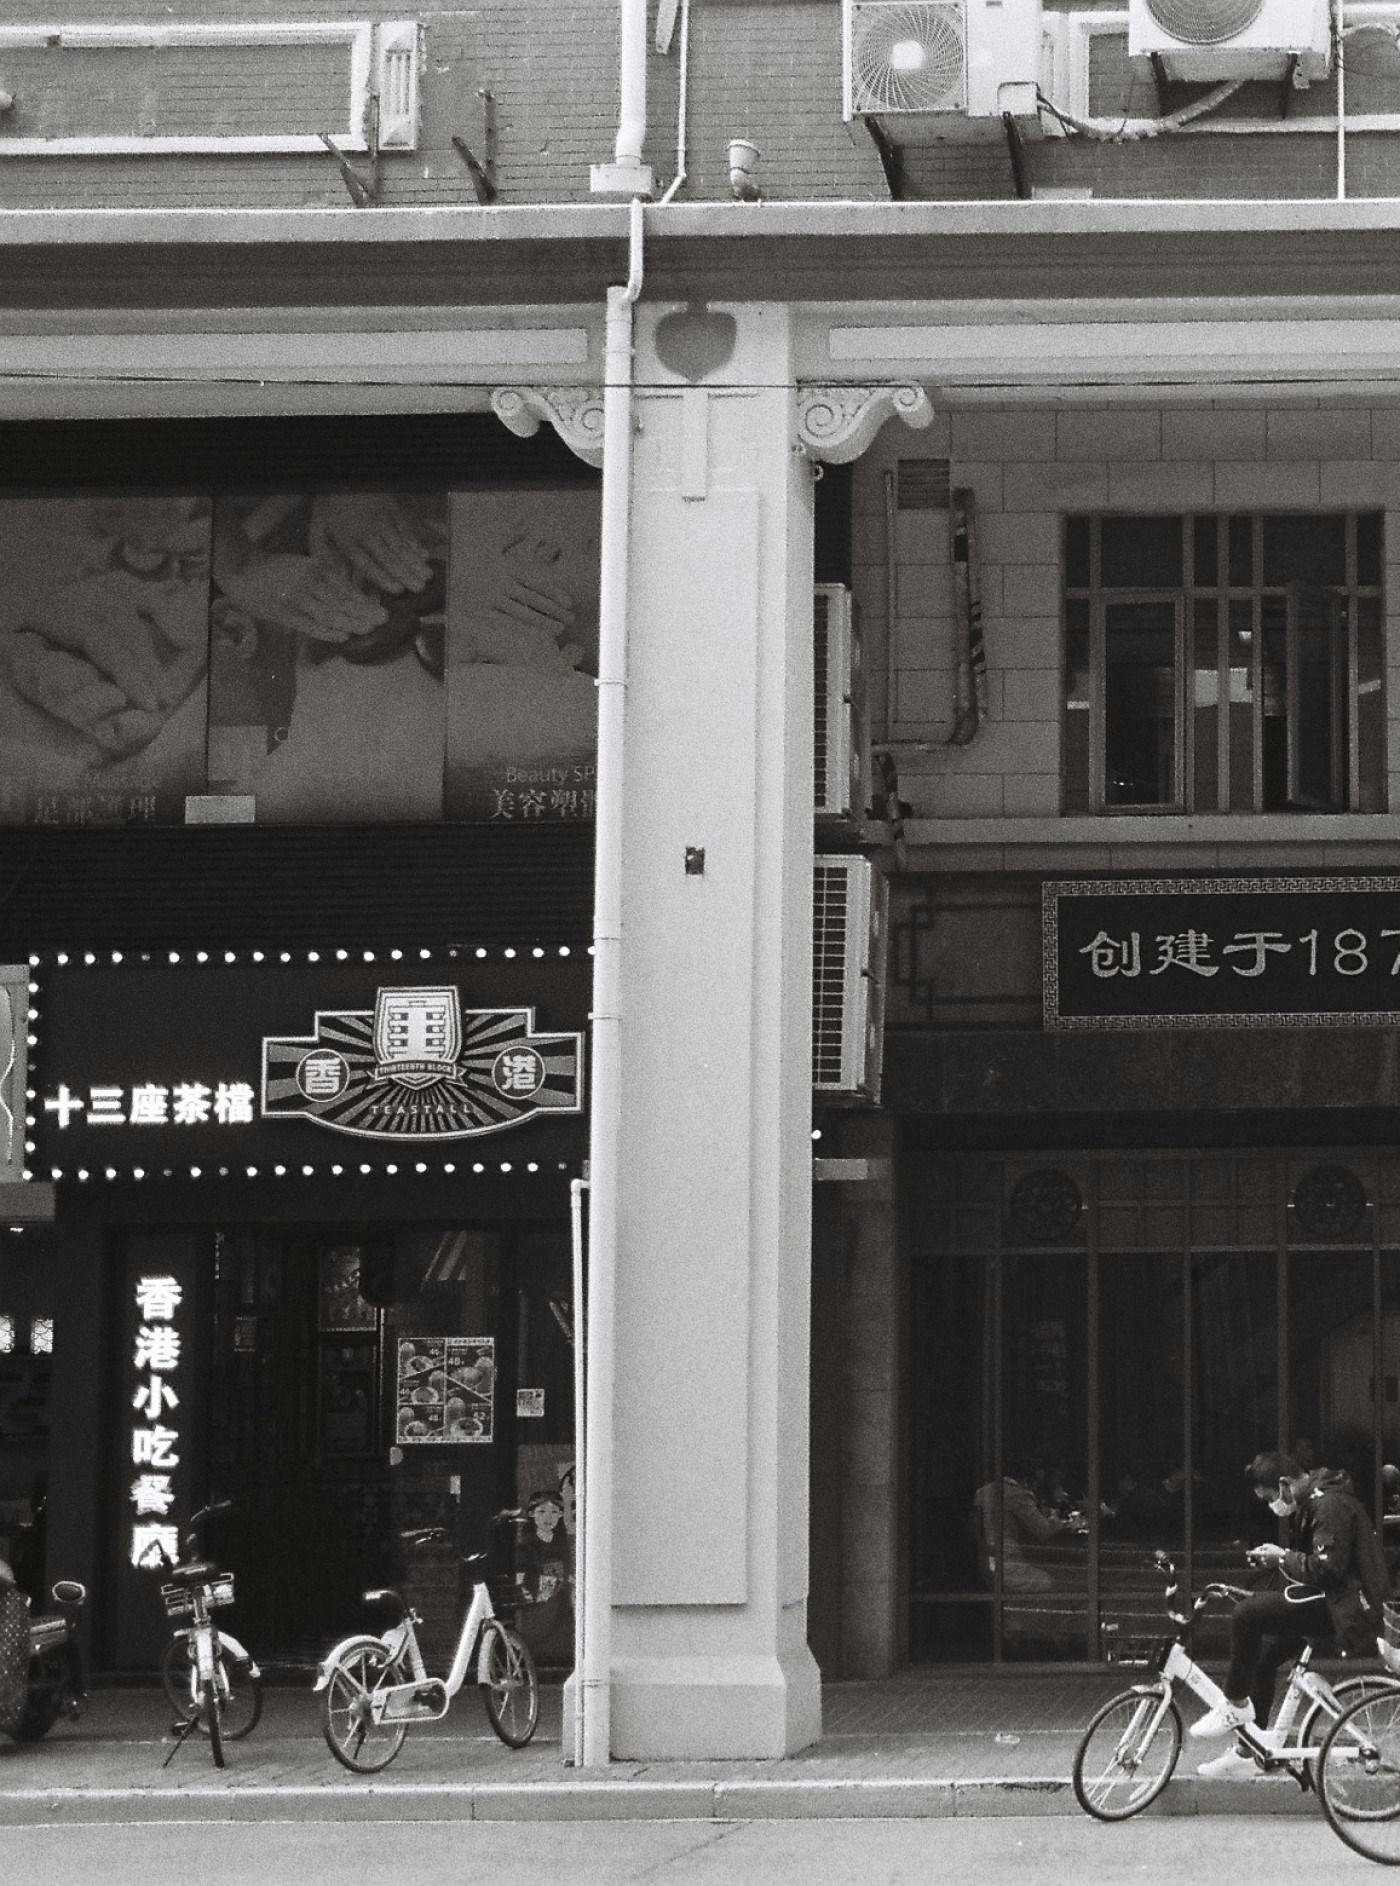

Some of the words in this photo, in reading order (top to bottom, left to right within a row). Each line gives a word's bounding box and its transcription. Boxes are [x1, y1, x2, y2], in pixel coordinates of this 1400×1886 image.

[506, 766, 571, 785] Beauty
[304, 1057, 342, 1095] 香
[502, 1054, 537, 1091] 港
[427, 1063, 452, 1073] BLOCK
[44, 1082, 254, 1129] 十三座茶檔
[371, 1104, 471, 1115] TEASTALL
[131, 1276, 182, 1568] 香港小吃餐廳
